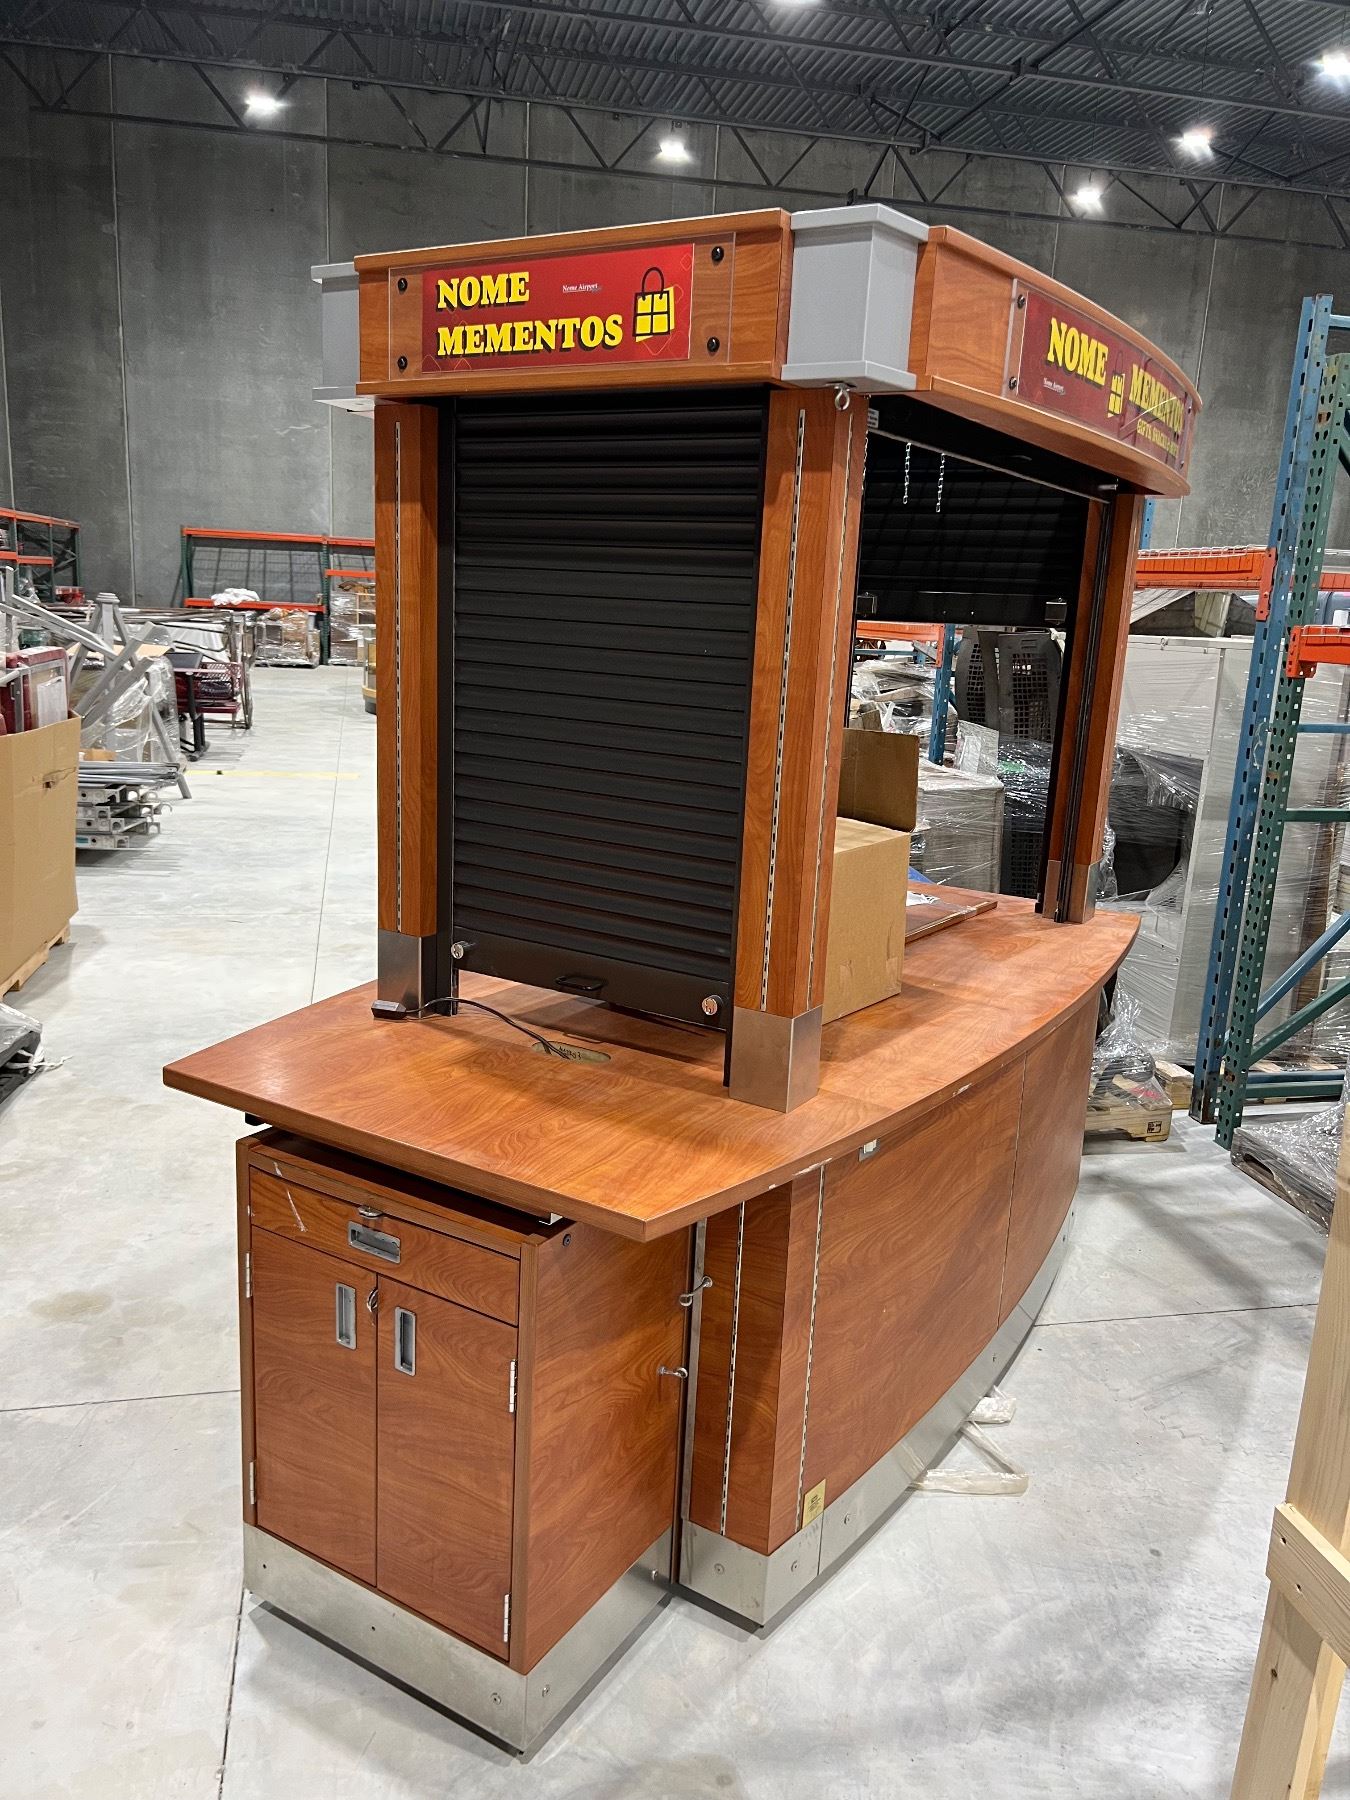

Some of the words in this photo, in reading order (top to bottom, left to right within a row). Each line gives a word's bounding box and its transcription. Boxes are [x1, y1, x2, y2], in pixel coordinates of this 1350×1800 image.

[437, 271, 530, 309] NOME
[437, 313, 623, 356] MEMENTOS
[1047, 317, 1109, 386] NOME
